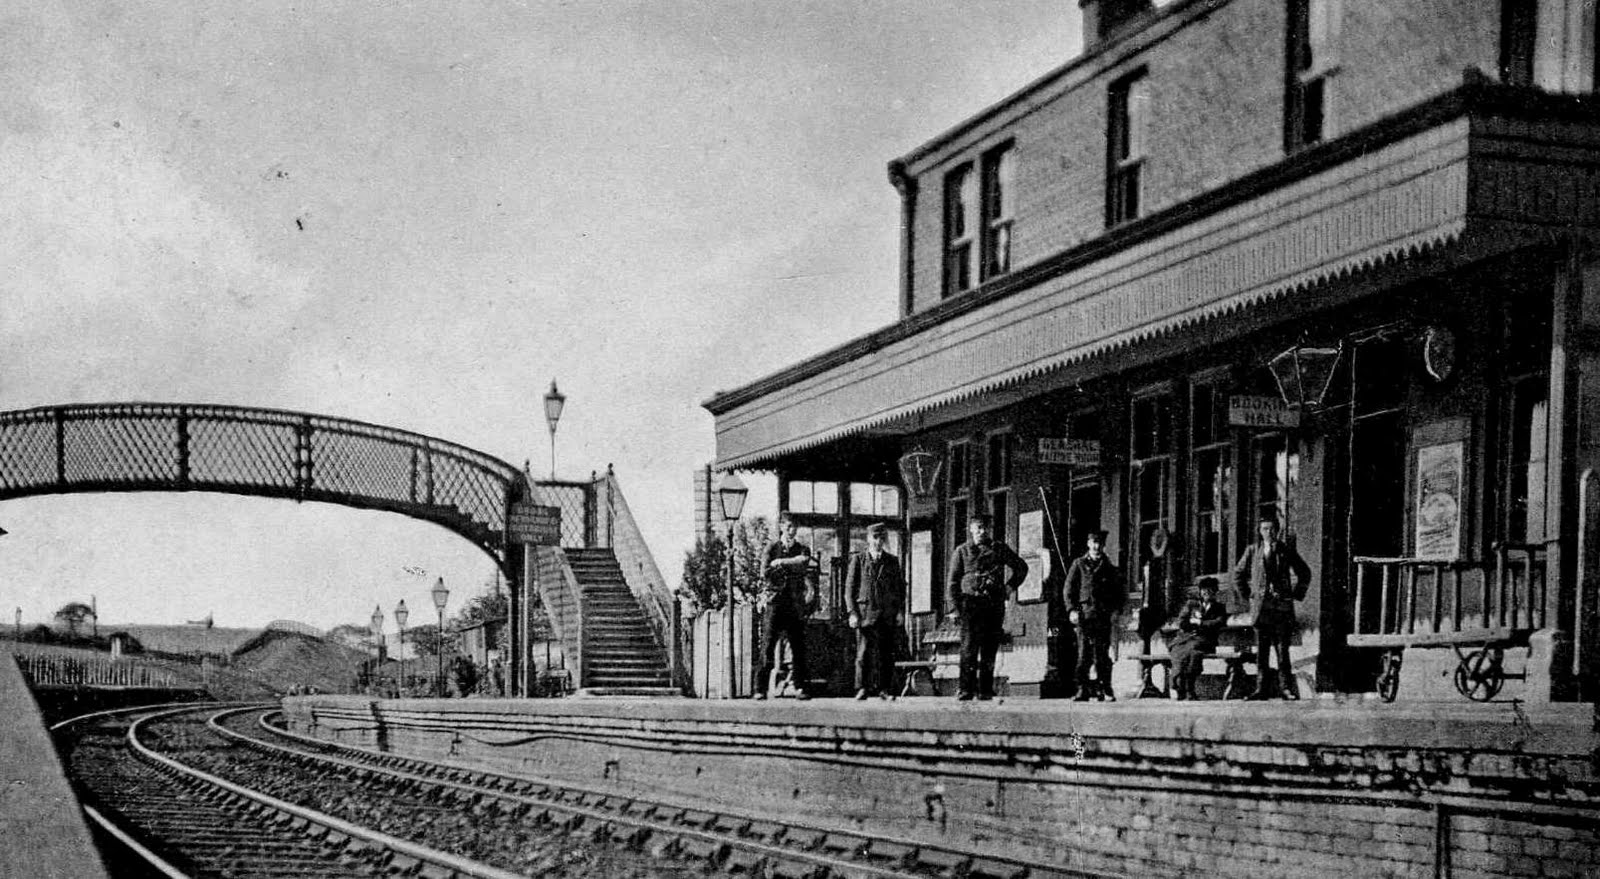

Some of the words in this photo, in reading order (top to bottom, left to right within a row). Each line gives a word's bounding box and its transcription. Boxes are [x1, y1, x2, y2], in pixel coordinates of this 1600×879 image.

[1231, 397, 1298, 410] BOOKIN
[1244, 412, 1283, 425] HALL
[520, 533, 543, 542] ONLY
